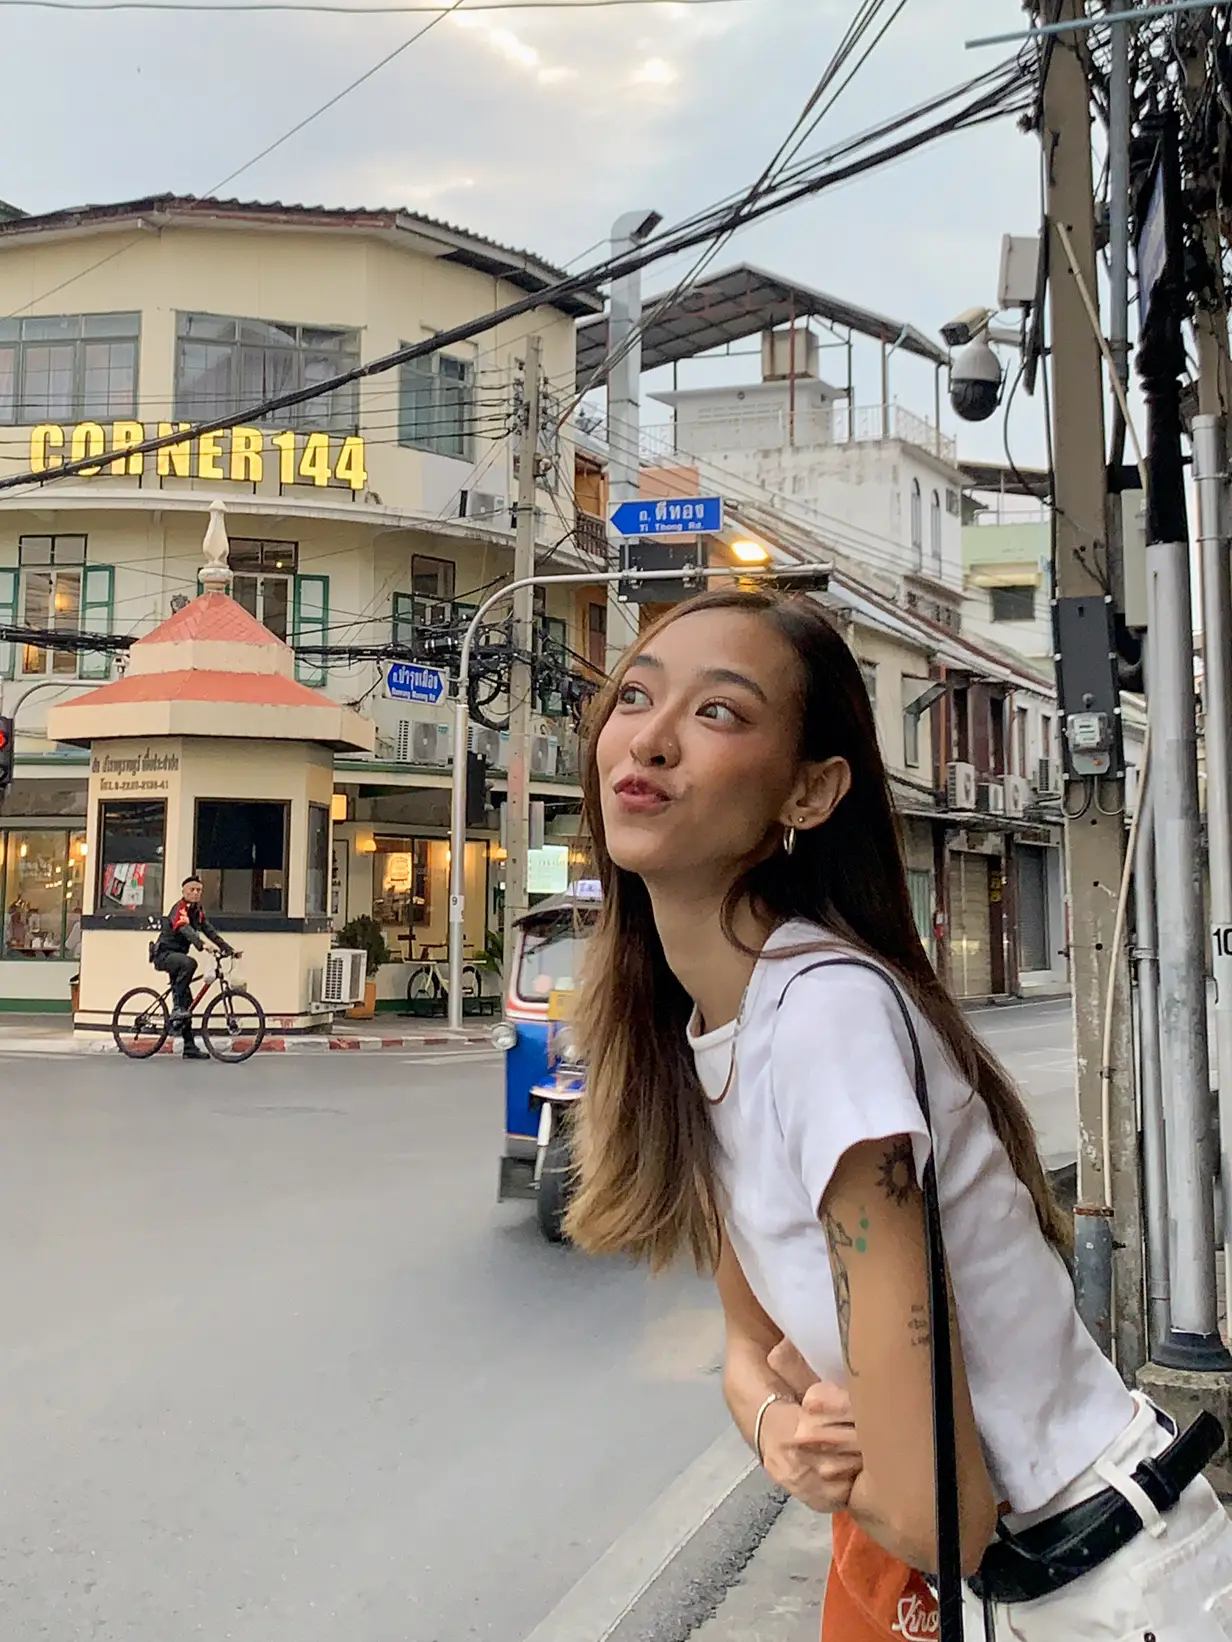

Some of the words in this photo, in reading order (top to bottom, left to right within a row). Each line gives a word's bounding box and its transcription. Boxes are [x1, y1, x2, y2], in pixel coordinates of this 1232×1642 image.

[29, 420, 264, 483] CORNER
[272, 429, 368, 491] 144
[640, 523, 649, 532] Ti
[655, 523, 682, 531] Thong
[451, 896, 458, 906] 9
